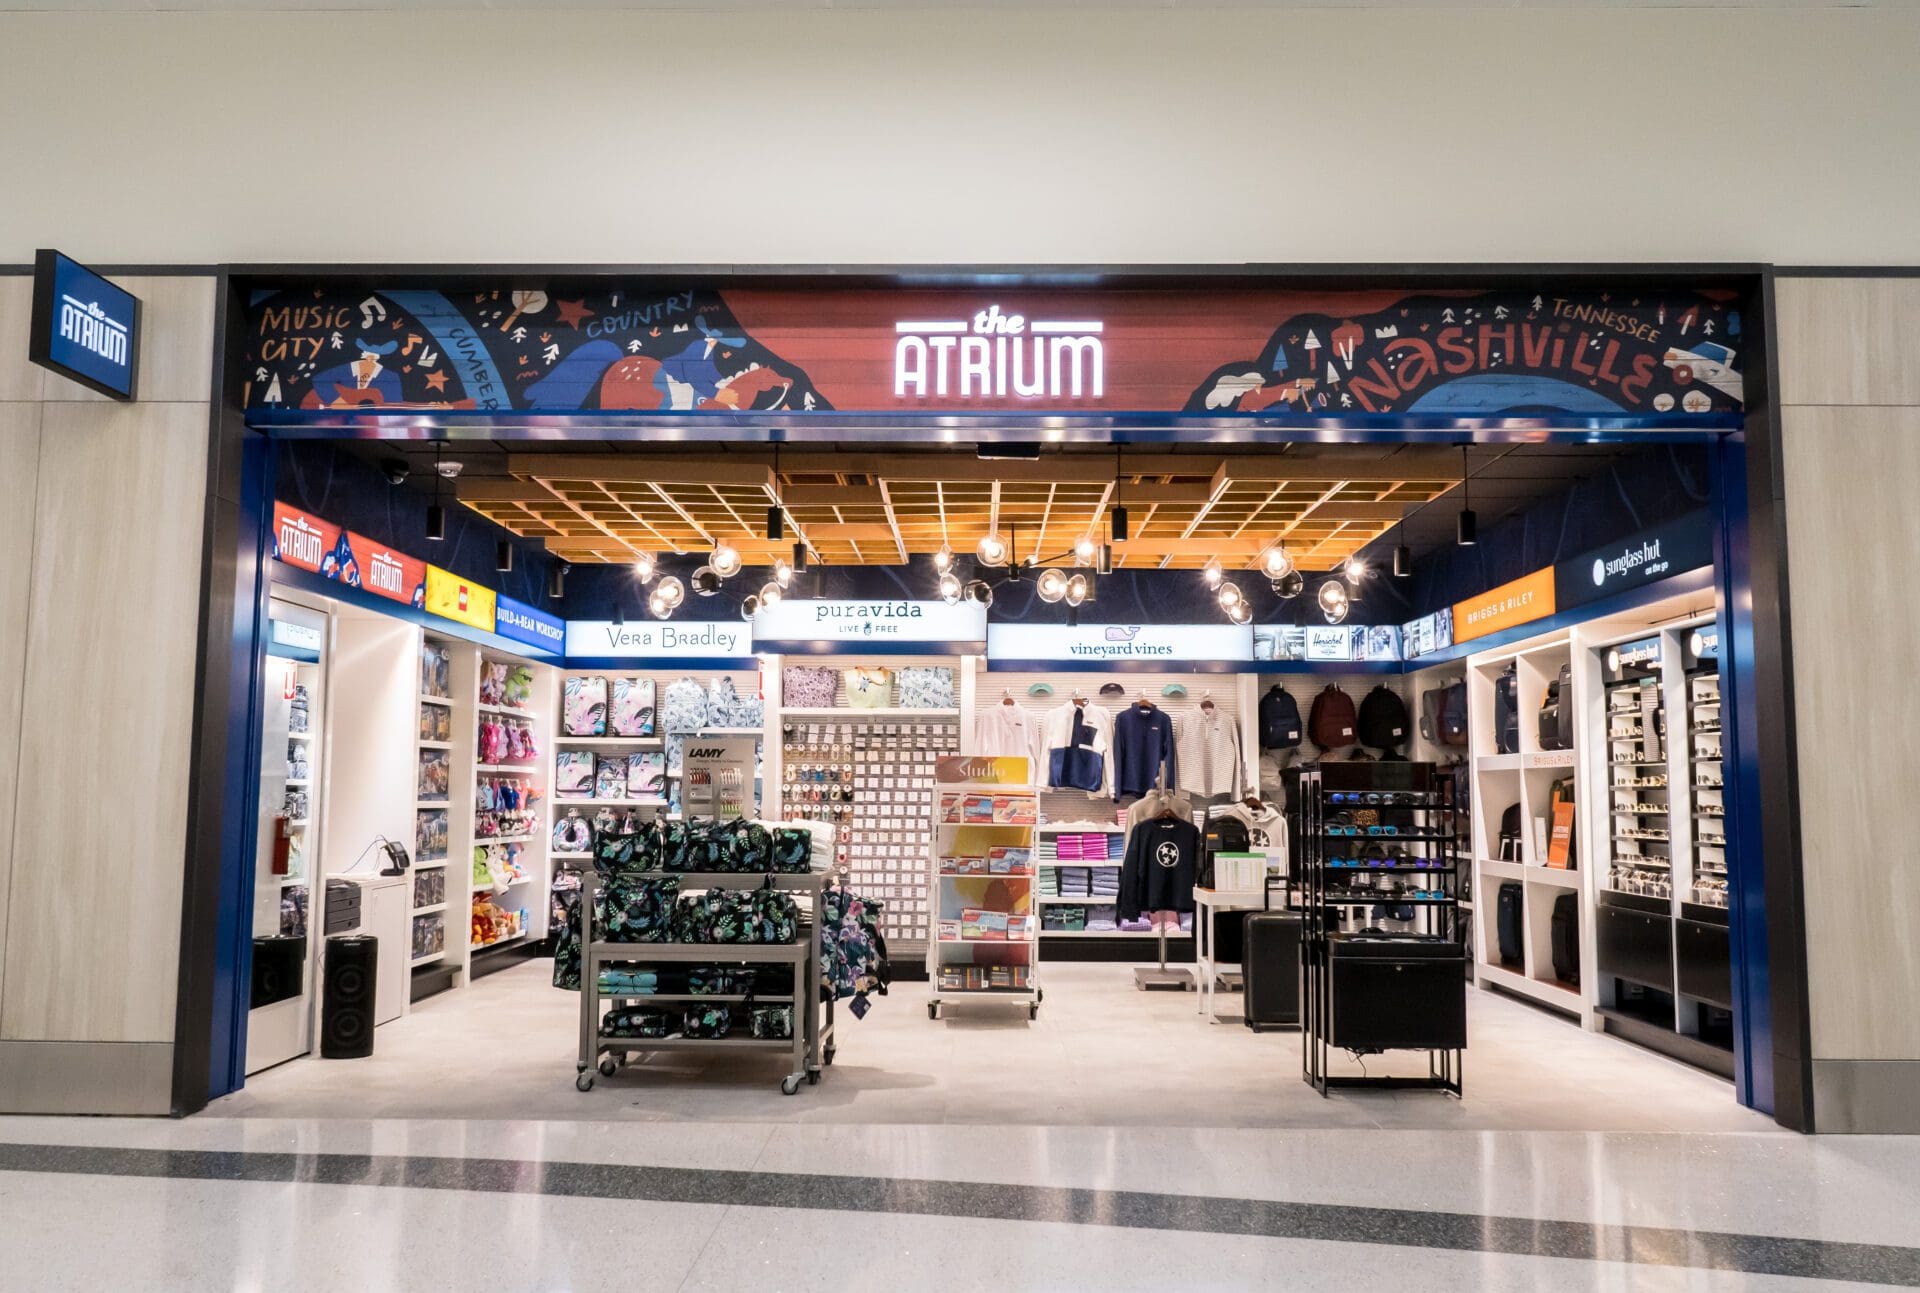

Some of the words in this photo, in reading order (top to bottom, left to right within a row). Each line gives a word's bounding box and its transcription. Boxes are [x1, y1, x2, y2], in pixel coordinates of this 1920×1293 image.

[87, 301, 105, 320] the
[586, 289, 694, 338] COUNTRY
[973, 304, 1025, 334] the
[1552, 298, 1662, 344] TENNESSEE
[60, 303, 127, 366] ATRIUM
[894, 335, 1104, 396] ATRIUM
[280, 524, 322, 568] ATRIUM
[1605, 548, 1644, 576] sunglass
[1643, 538, 1661, 562] hut
[370, 559, 403, 594] ATRIUM
[816, 602, 923, 621] puravida
[1467, 604, 1498, 625] BRIGGS
[1507, 591, 1534, 610] RILEY
[662, 624, 737, 652] Bradley
[839, 625, 860, 633] LIVE
[875, 625, 898, 633] FREE
[1313, 632, 1344, 647] Herschel
[1070, 642, 1132, 658] vineyard
[1135, 642, 1173, 655] vines
[688, 748, 726, 759] LAMY
[959, 761, 1007, 777] studio
